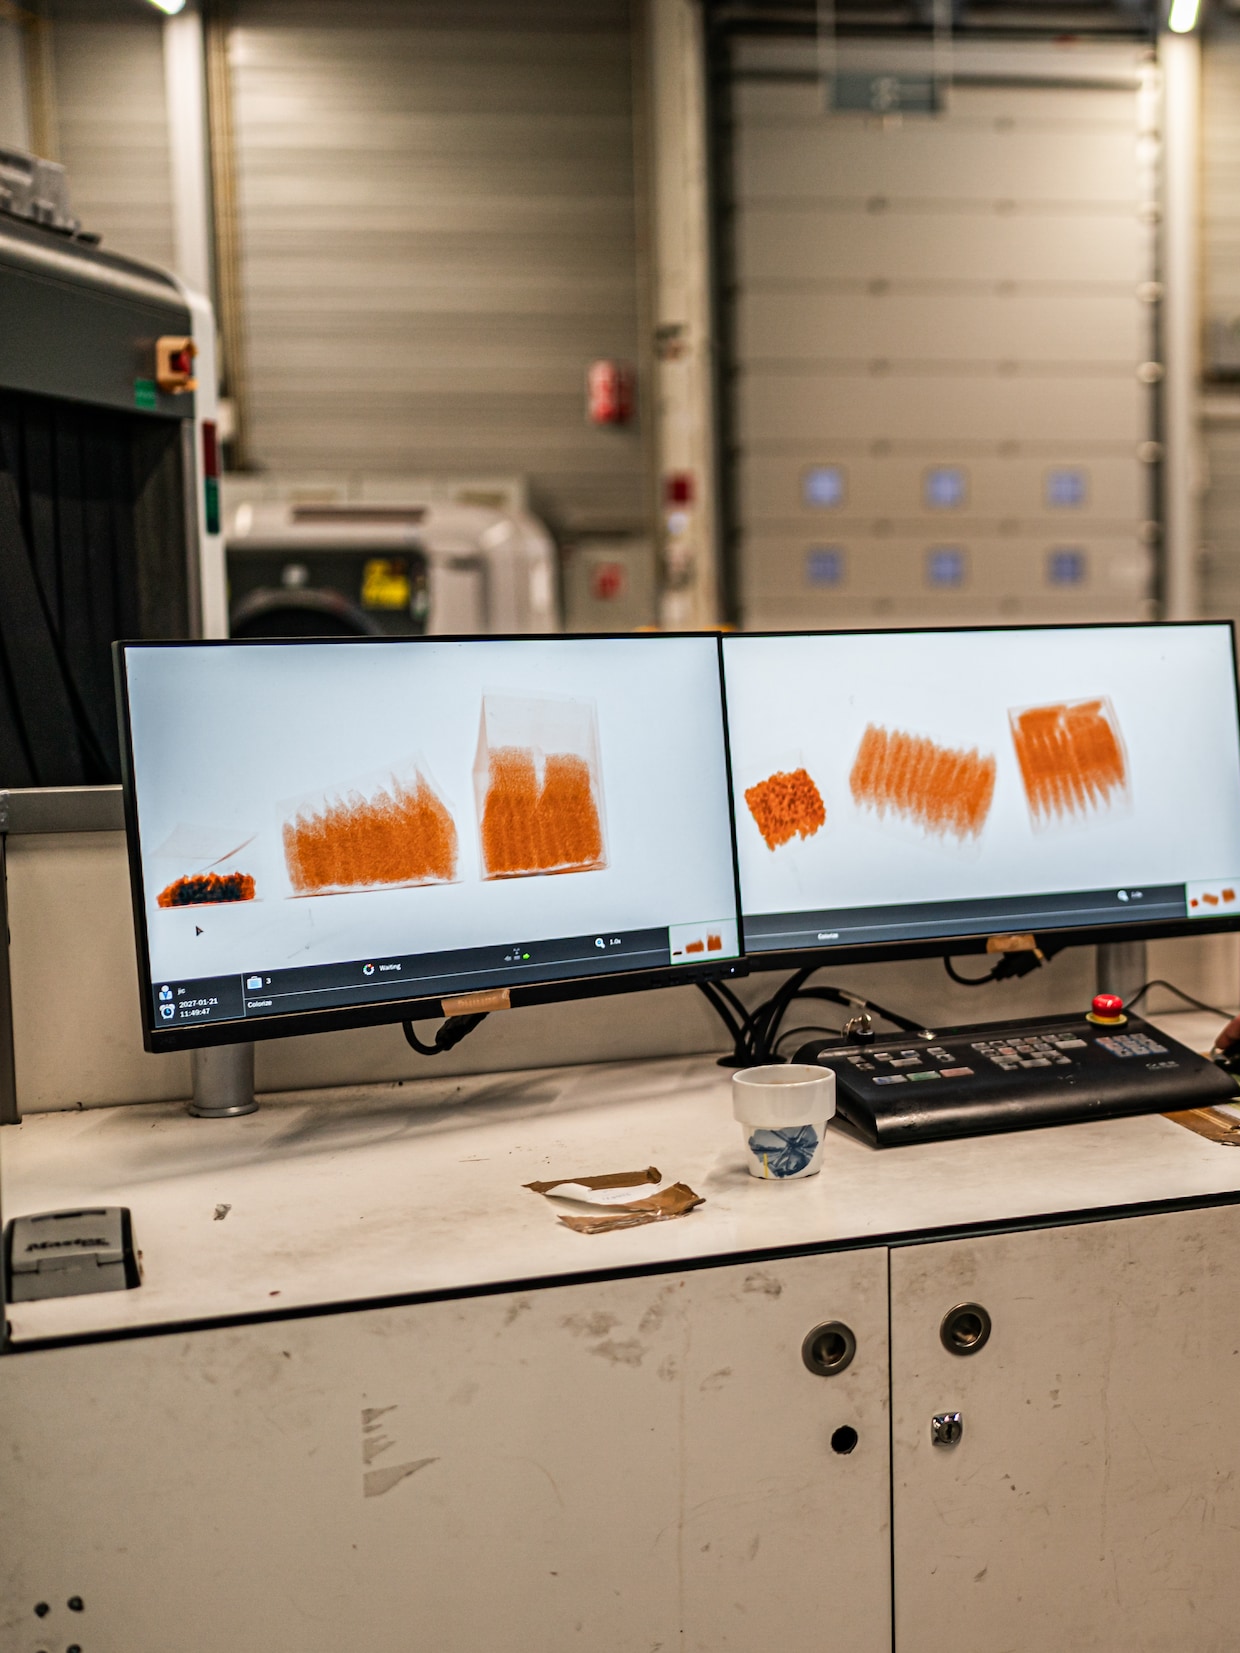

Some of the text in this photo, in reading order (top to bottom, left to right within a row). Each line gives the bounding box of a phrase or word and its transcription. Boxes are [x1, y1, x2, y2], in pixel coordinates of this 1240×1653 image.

[379, 963, 402, 972] Waiting
[265, 977, 272, 985] 3
[178, 997, 218, 1009] 2027-01-21
[247, 1000, 273, 1008] Colorize
[180, 1008, 211, 1018] 11:49:47
